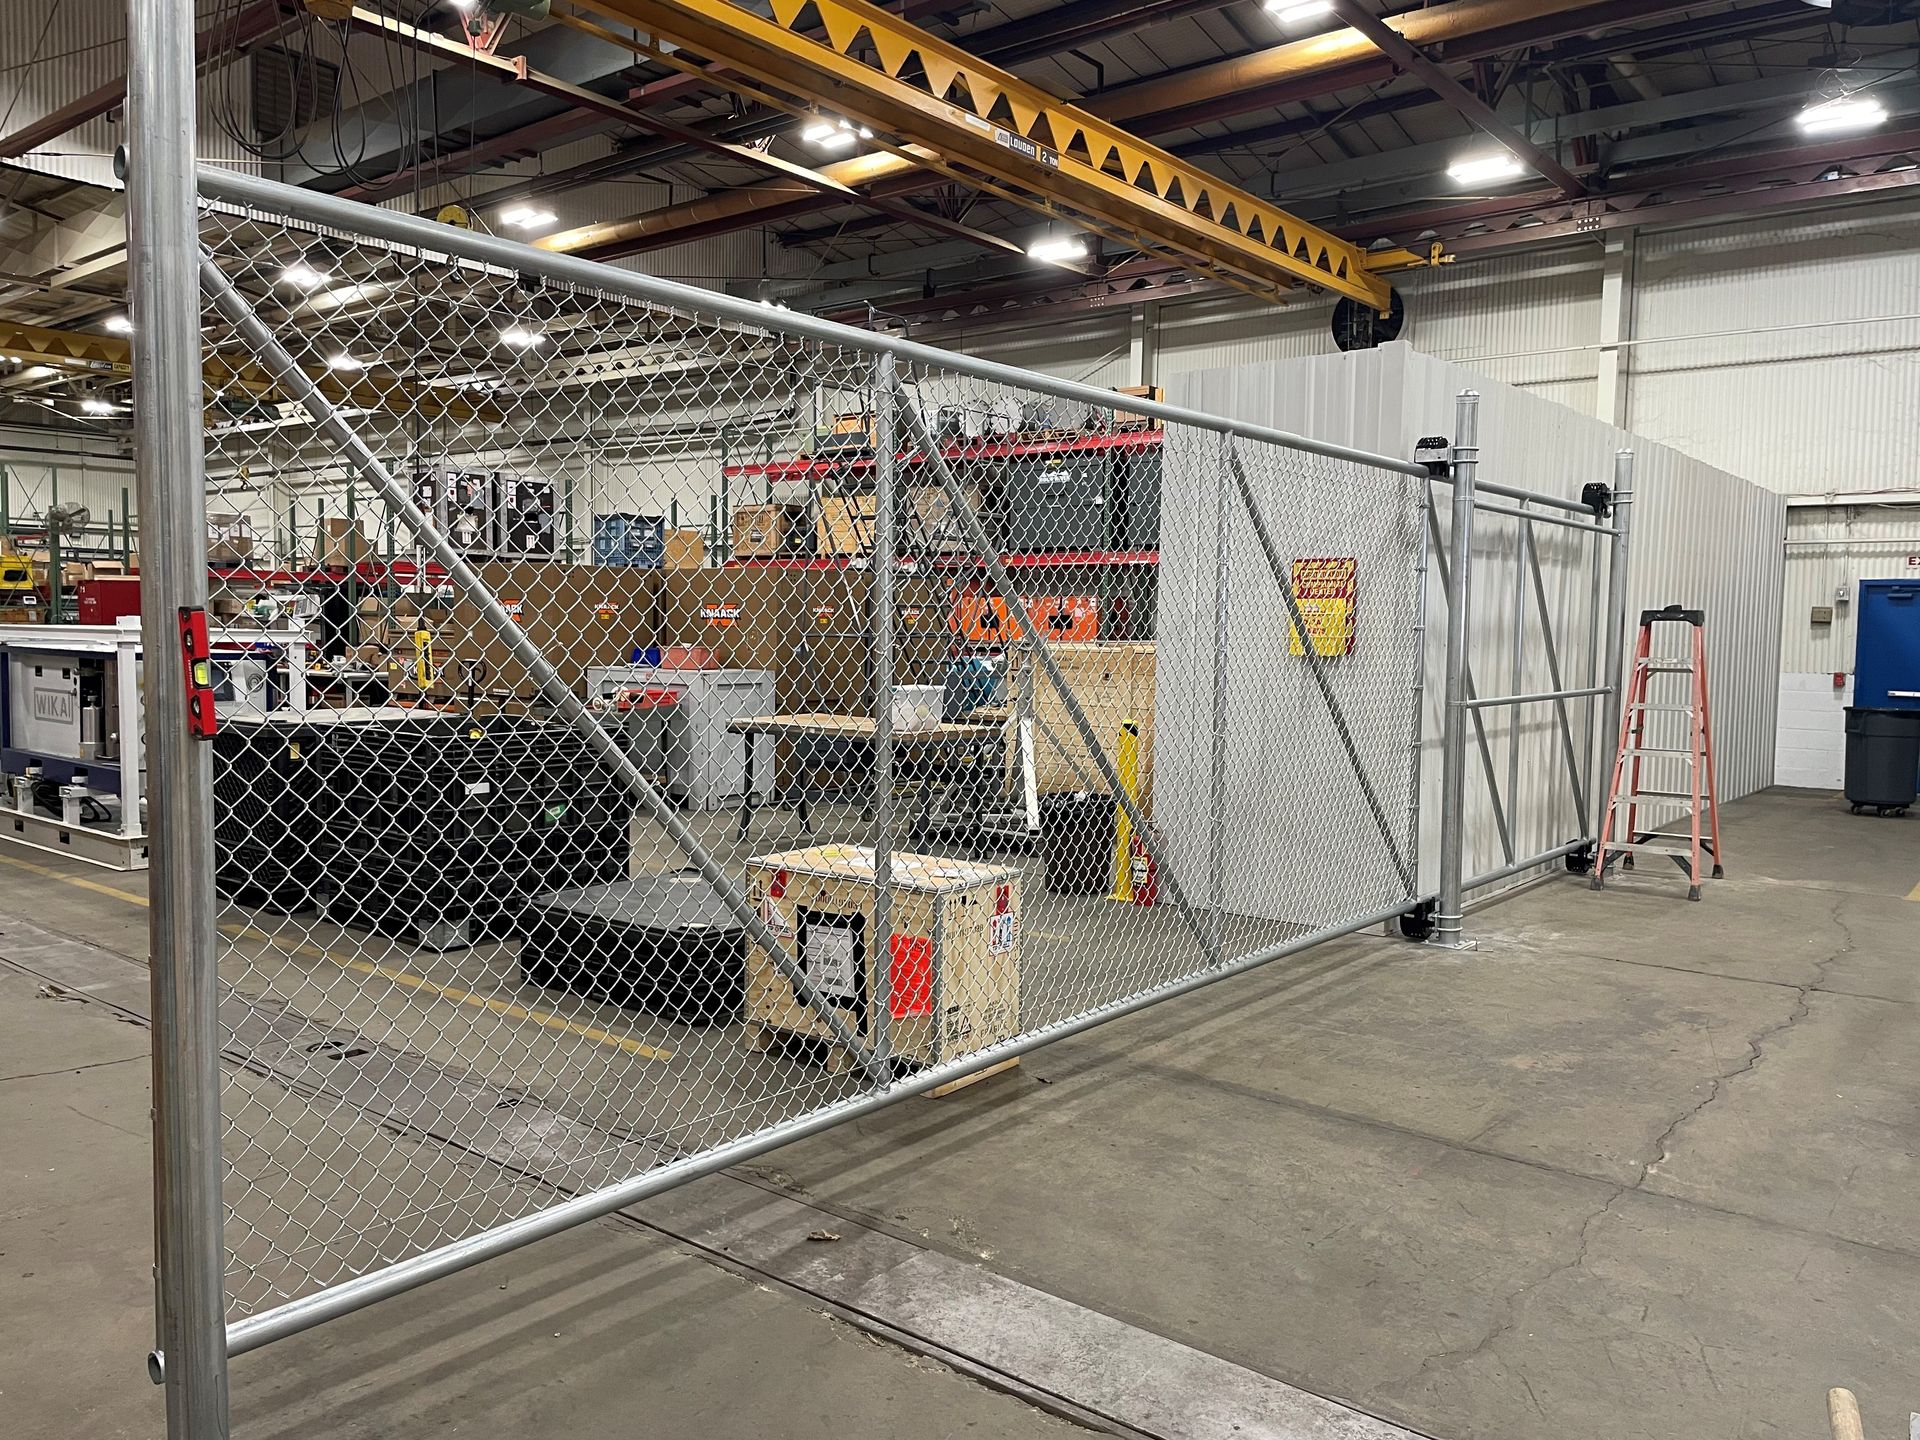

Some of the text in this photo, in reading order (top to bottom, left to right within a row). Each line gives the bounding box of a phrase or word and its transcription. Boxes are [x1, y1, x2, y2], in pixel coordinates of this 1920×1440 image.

[1042, 151, 1058, 167] 2 TON
[1908, 556, 1920, 566] E
[700, 608, 741, 618] KNAACK
[36, 693, 67, 718] WIKA
